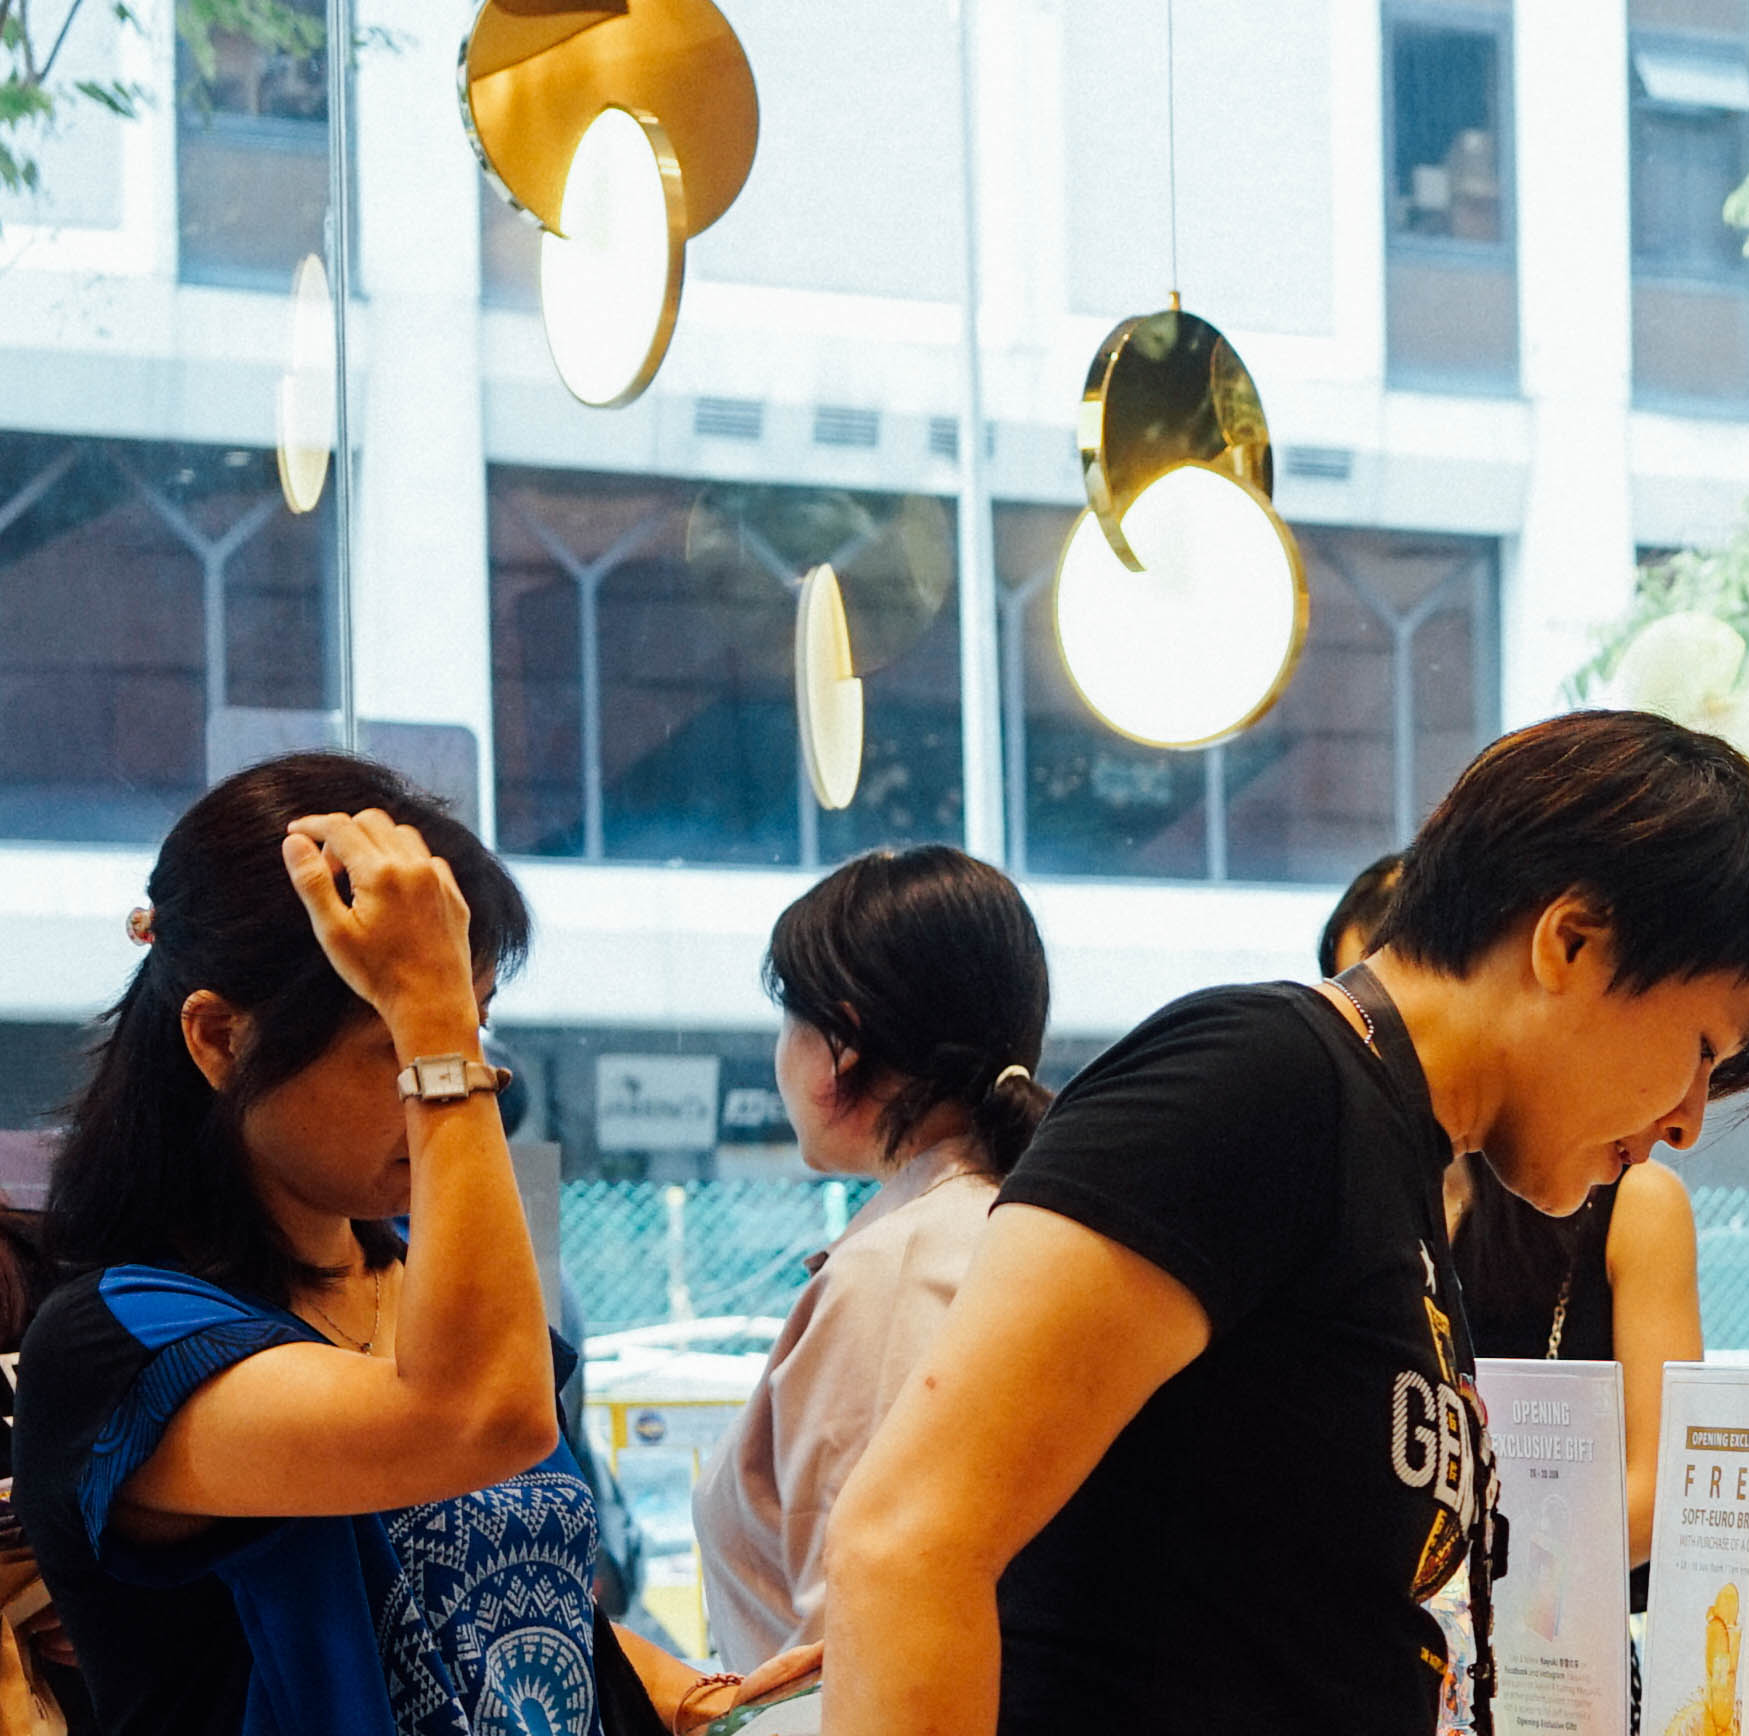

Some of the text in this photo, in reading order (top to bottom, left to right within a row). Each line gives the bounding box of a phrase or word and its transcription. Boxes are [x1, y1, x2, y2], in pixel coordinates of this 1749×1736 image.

[1511, 1400, 1571, 1427] OPENING
[1491, 1434, 1595, 1462] EXCLUSIVE GIFT
[1692, 1431, 1728, 1447] OPENING
[1681, 1507, 1735, 1529] SOFT-EURO
